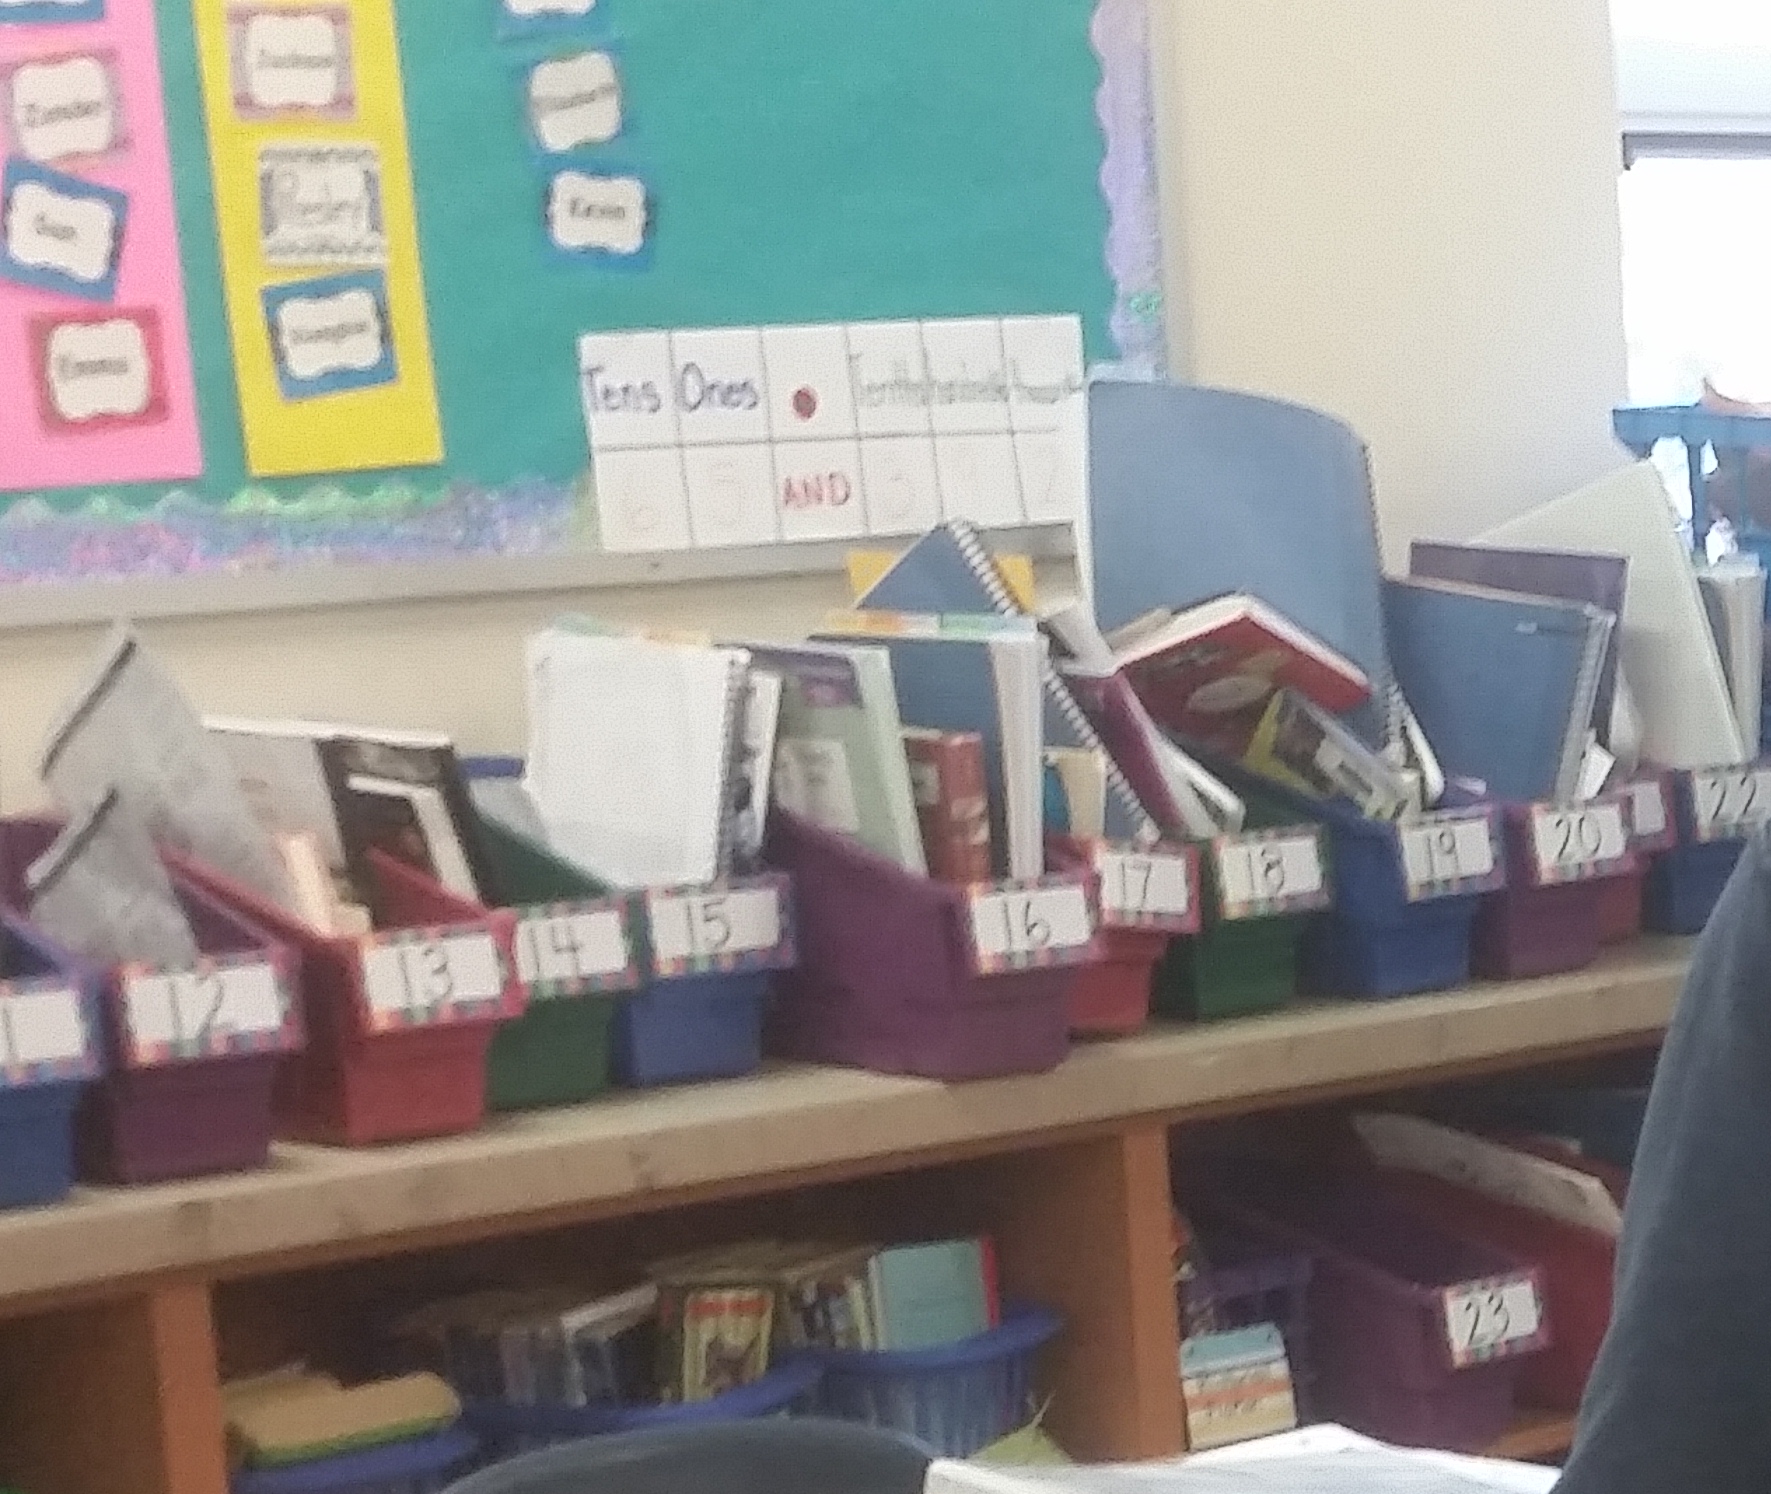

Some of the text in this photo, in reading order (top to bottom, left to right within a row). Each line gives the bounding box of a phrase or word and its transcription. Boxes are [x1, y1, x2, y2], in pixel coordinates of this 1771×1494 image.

[584, 361, 759, 414] Tens Ones
[782, 471, 851, 507] AND
[1709, 776, 1761, 826] 22
[1425, 828, 1461, 880] 19
[1554, 814, 1603, 864] 20
[1120, 859, 1152, 906] 17
[528, 918, 581, 980] 14
[685, 898, 731, 952] 15
[1003, 895, 1051, 950] 16
[398, 942, 454, 1005] 13
[167, 972, 232, 1044] 12
[1463, 1291, 1511, 1350] 23
